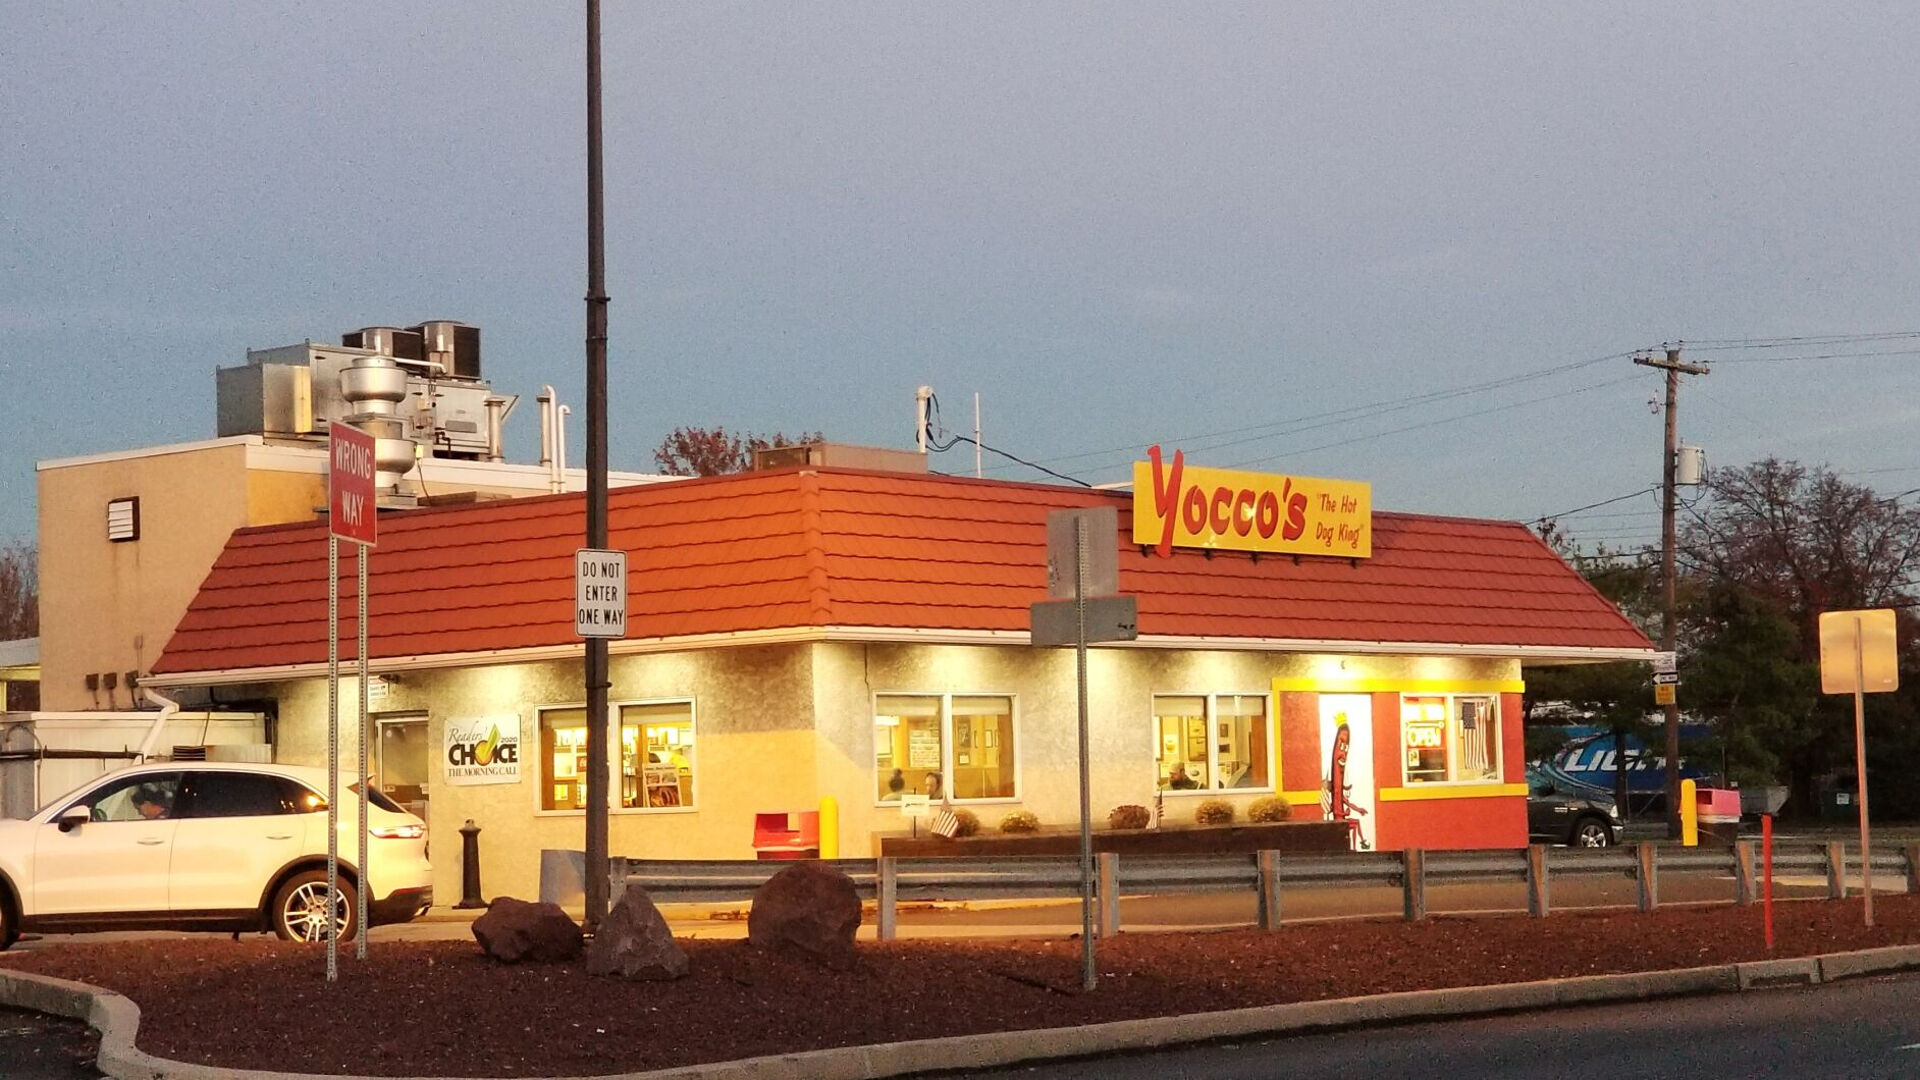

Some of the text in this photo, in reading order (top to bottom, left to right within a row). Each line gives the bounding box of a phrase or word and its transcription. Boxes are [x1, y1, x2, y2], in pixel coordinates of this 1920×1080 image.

[335, 438, 371, 480] WRONG
[342, 491, 363, 526] WAY
[1341, 494, 1357, 513] Hot
[1316, 521, 1334, 547] Dog
[583, 561, 620, 578] DO NOT
[585, 585, 617, 602] ENTER
[579, 608, 624, 625] ONE WAY
[448, 739, 518, 766] CHOICE
[448, 766, 517, 777] THE MORNING CALL
